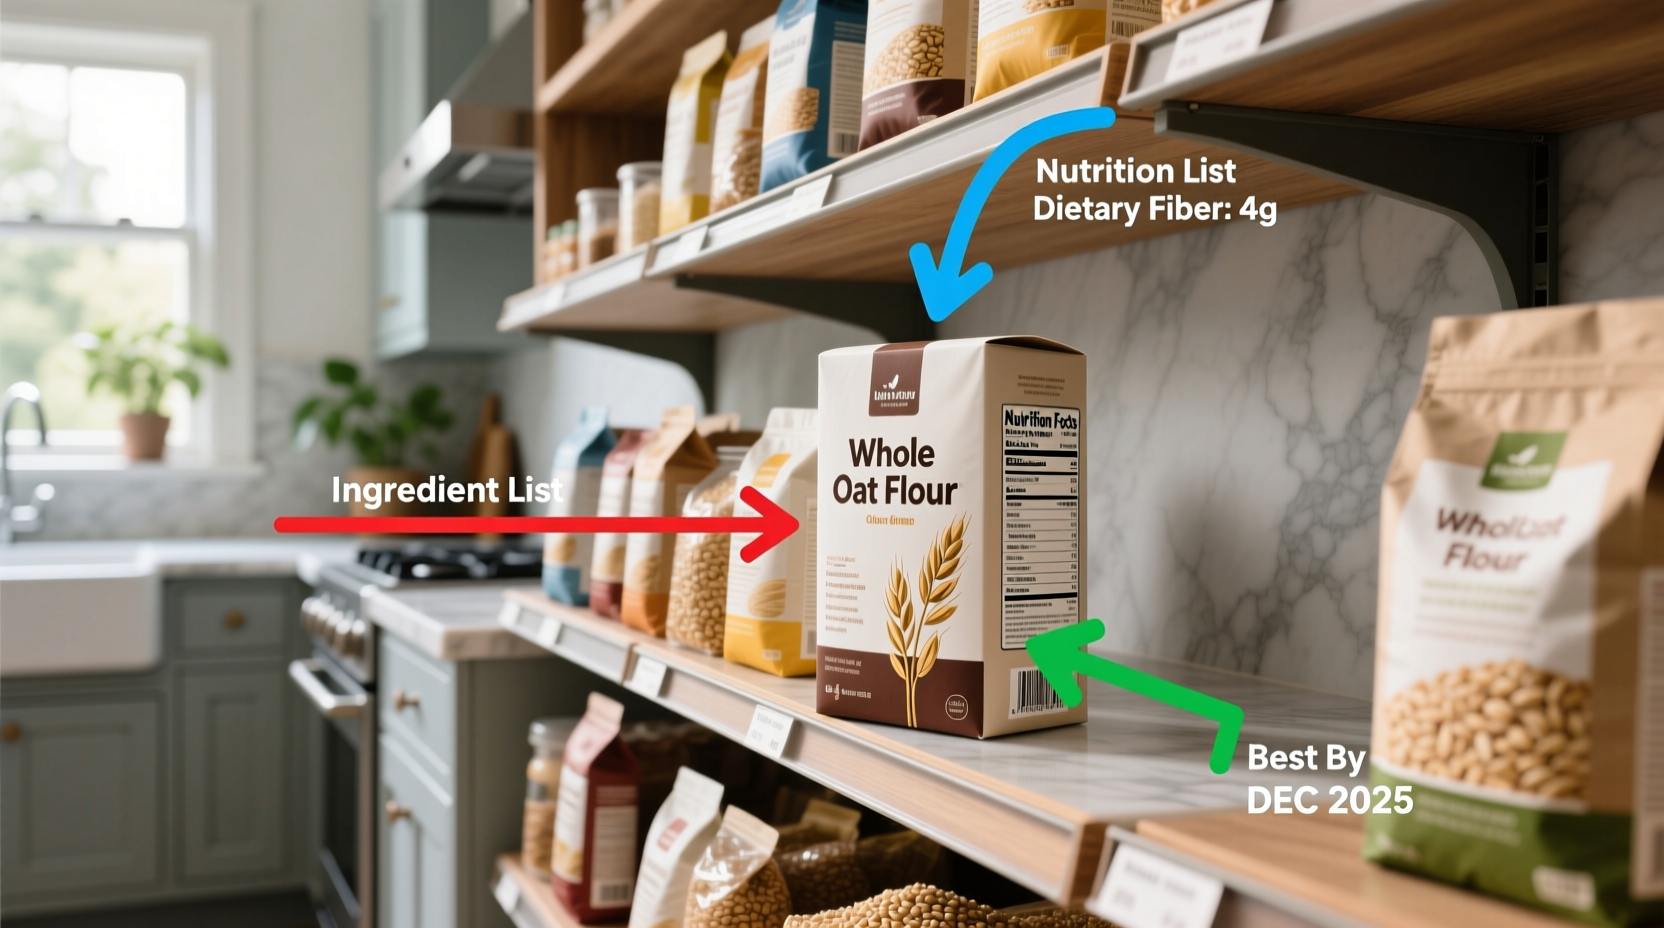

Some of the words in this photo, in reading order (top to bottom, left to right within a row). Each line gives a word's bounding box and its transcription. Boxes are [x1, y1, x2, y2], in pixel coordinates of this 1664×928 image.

[848, 436, 935, 468] Whole
[832, 473, 879, 505] Oat
[885, 474, 959, 506] Flour
[1443, 542, 1529, 572] Flour
